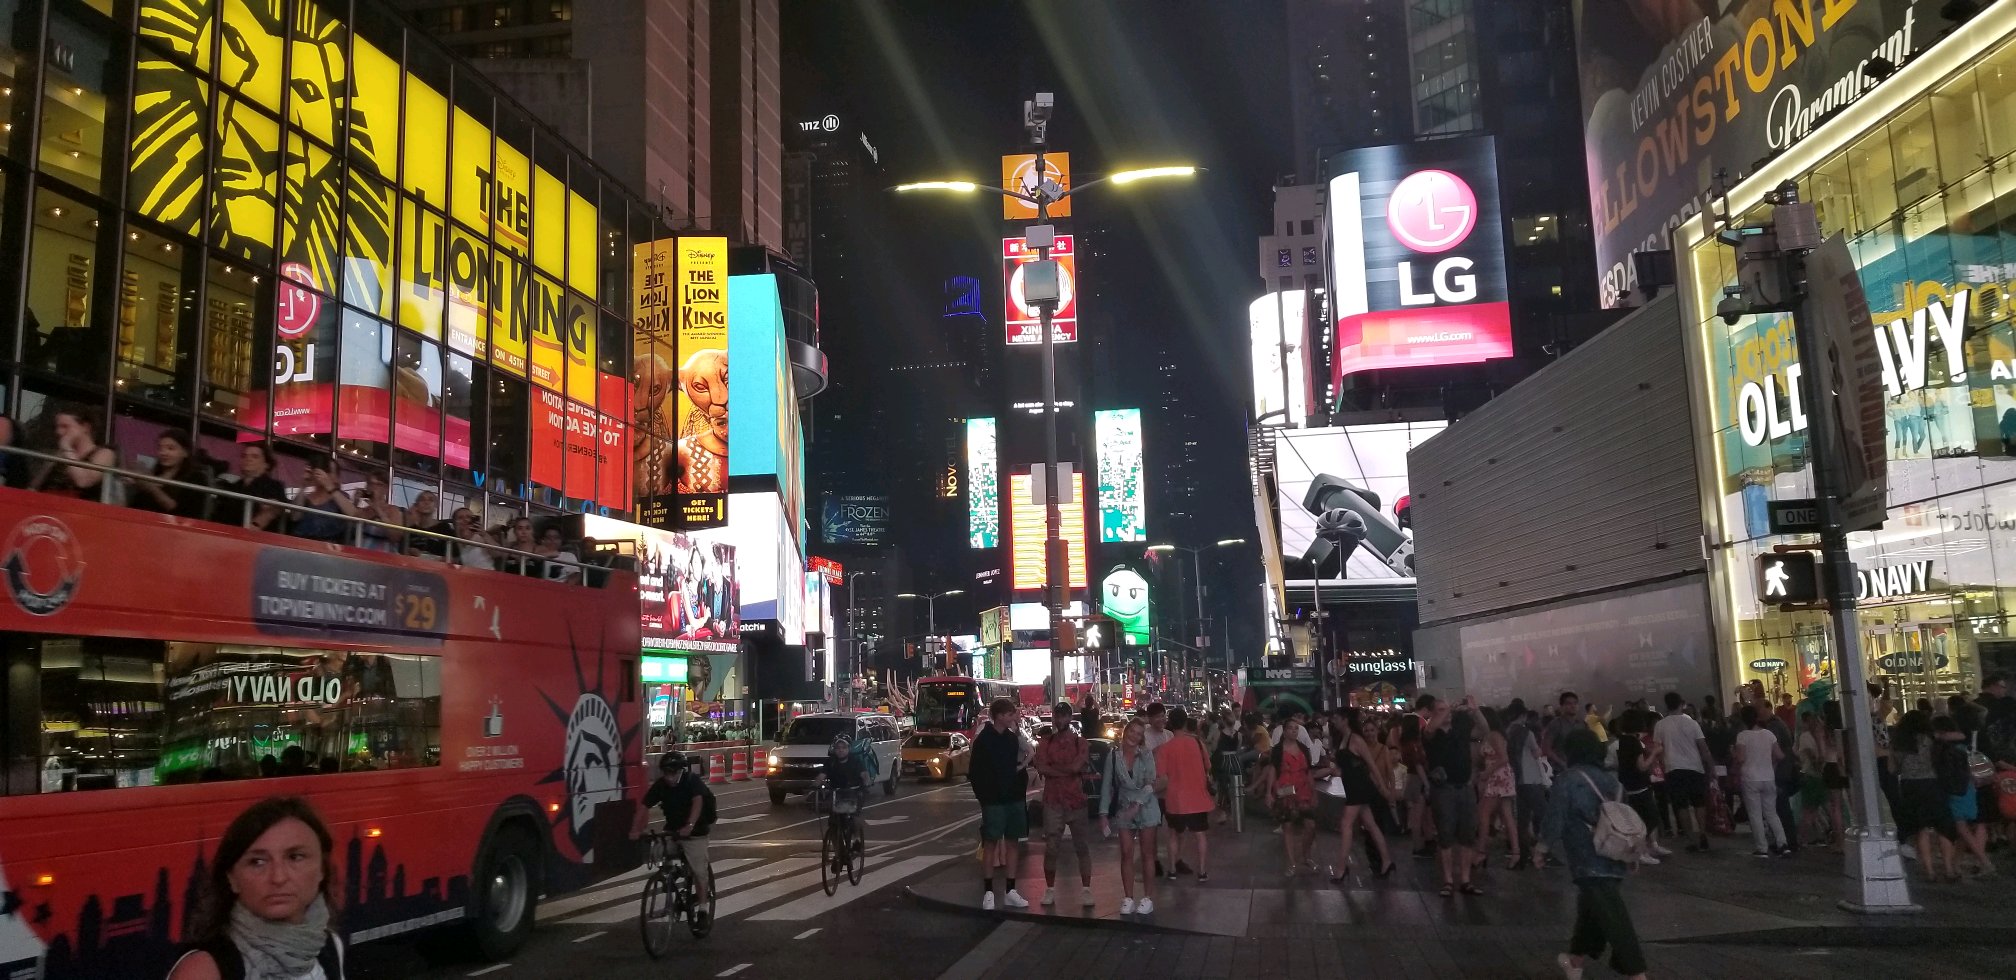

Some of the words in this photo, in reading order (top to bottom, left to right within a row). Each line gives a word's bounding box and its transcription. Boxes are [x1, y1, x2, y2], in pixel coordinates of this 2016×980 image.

[1630, 86, 1660, 134] KEVIN
[1661, 15, 1715, 99] COSTNER
[475, 165, 528, 237] THE
[413, 186, 504, 313] LION
[688, 270, 714, 282] THE
[1398, 256, 1477, 306] LG
[509, 244, 587, 355] KING
[684, 284, 720, 305] LION
[682, 305, 725, 330] KING
[1020, 324, 1063, 335] XINA
[1037, 332, 1072, 342] AENCY
[1407, 330, 1472, 345] www.LG.com
[1873, 288, 1971, 398] AVY
[451, 329, 487, 352] ENTRANCE
[494, 348, 506, 361] ON
[508, 352, 525, 370] 45TH
[531, 364, 551, 381] STREET
[682, 506, 714, 514] TICKETS
[686, 514, 710, 522] HERE!
[840, 503, 890, 521] FROZEN
[1785, 509, 1816, 523] ONE
[278, 570, 307, 591] BUY
[310, 574, 367, 599] TICKETS
[368, 584, 387, 600] AT
[1871, 560, 1931, 598] NAVY
[395, 593, 437, 629] $29
[740, 622, 760, 632] atch
[1349, 658, 1406, 675] sunglass
[1884, 657, 1906, 669] OLD
[1908, 656, 1941, 668] NAY
[1265, 669, 1292, 679] NYC
